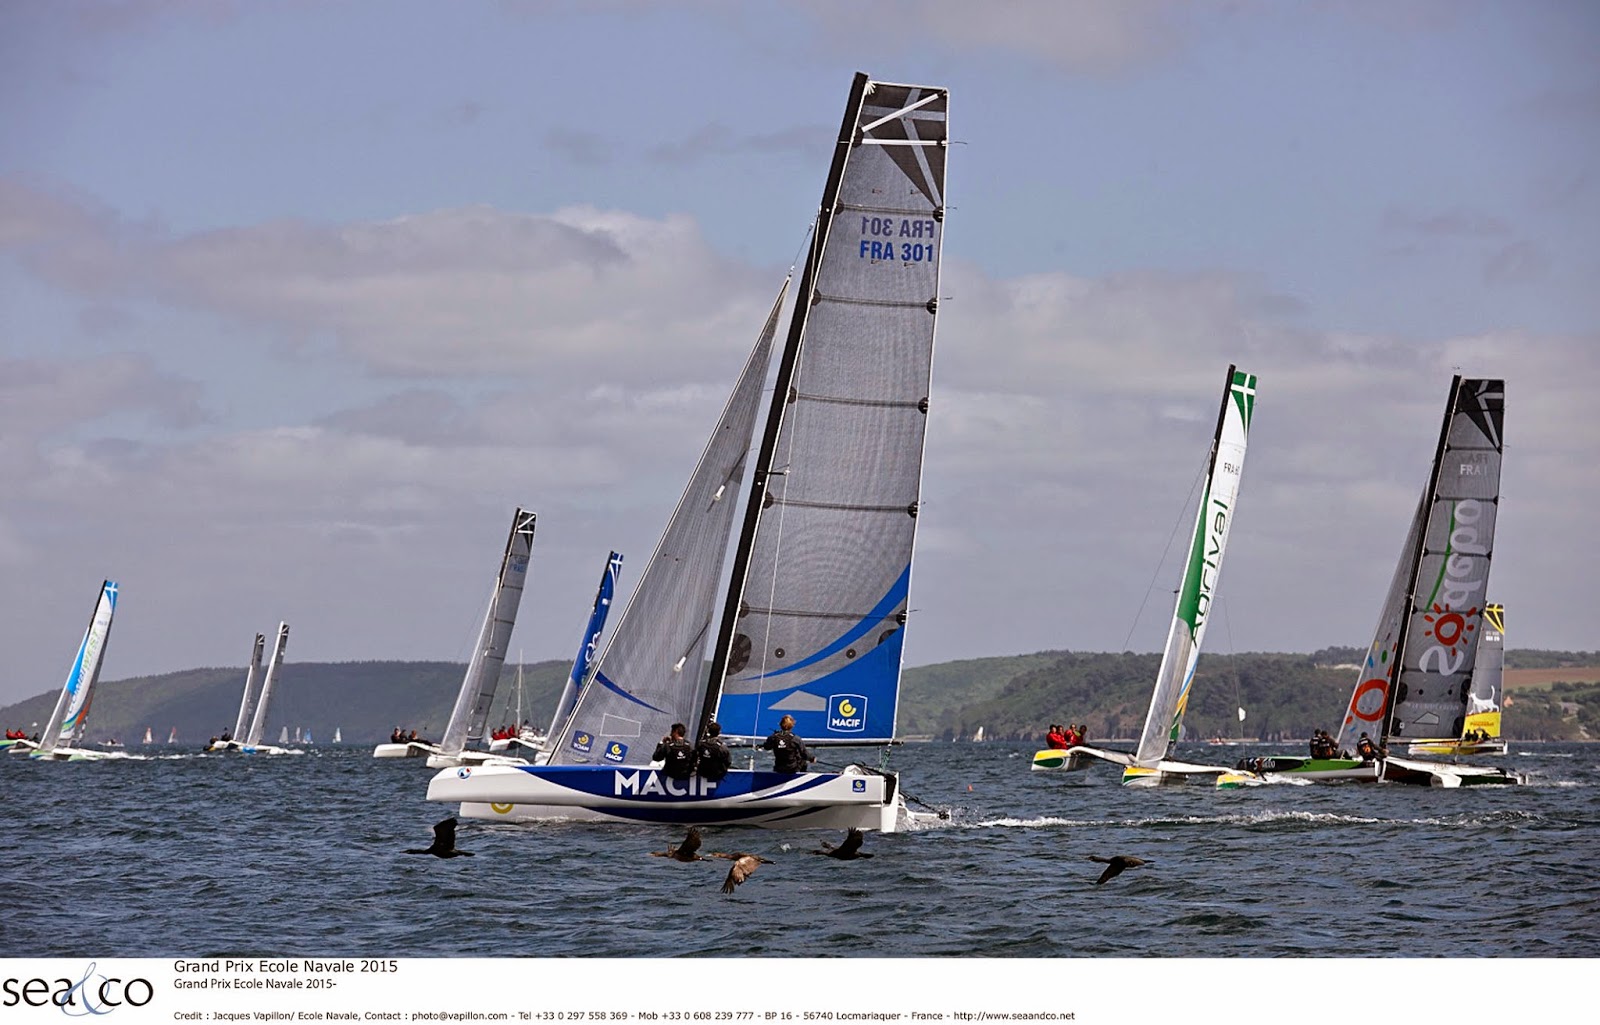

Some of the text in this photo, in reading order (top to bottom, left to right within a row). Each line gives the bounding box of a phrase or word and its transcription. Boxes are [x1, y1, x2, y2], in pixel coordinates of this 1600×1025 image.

[860, 240, 934, 262] FRA 301
[1460, 463, 1481, 476] FRA
[832, 718, 861, 727] MACIF
[605, 753, 623, 761] MACIF
